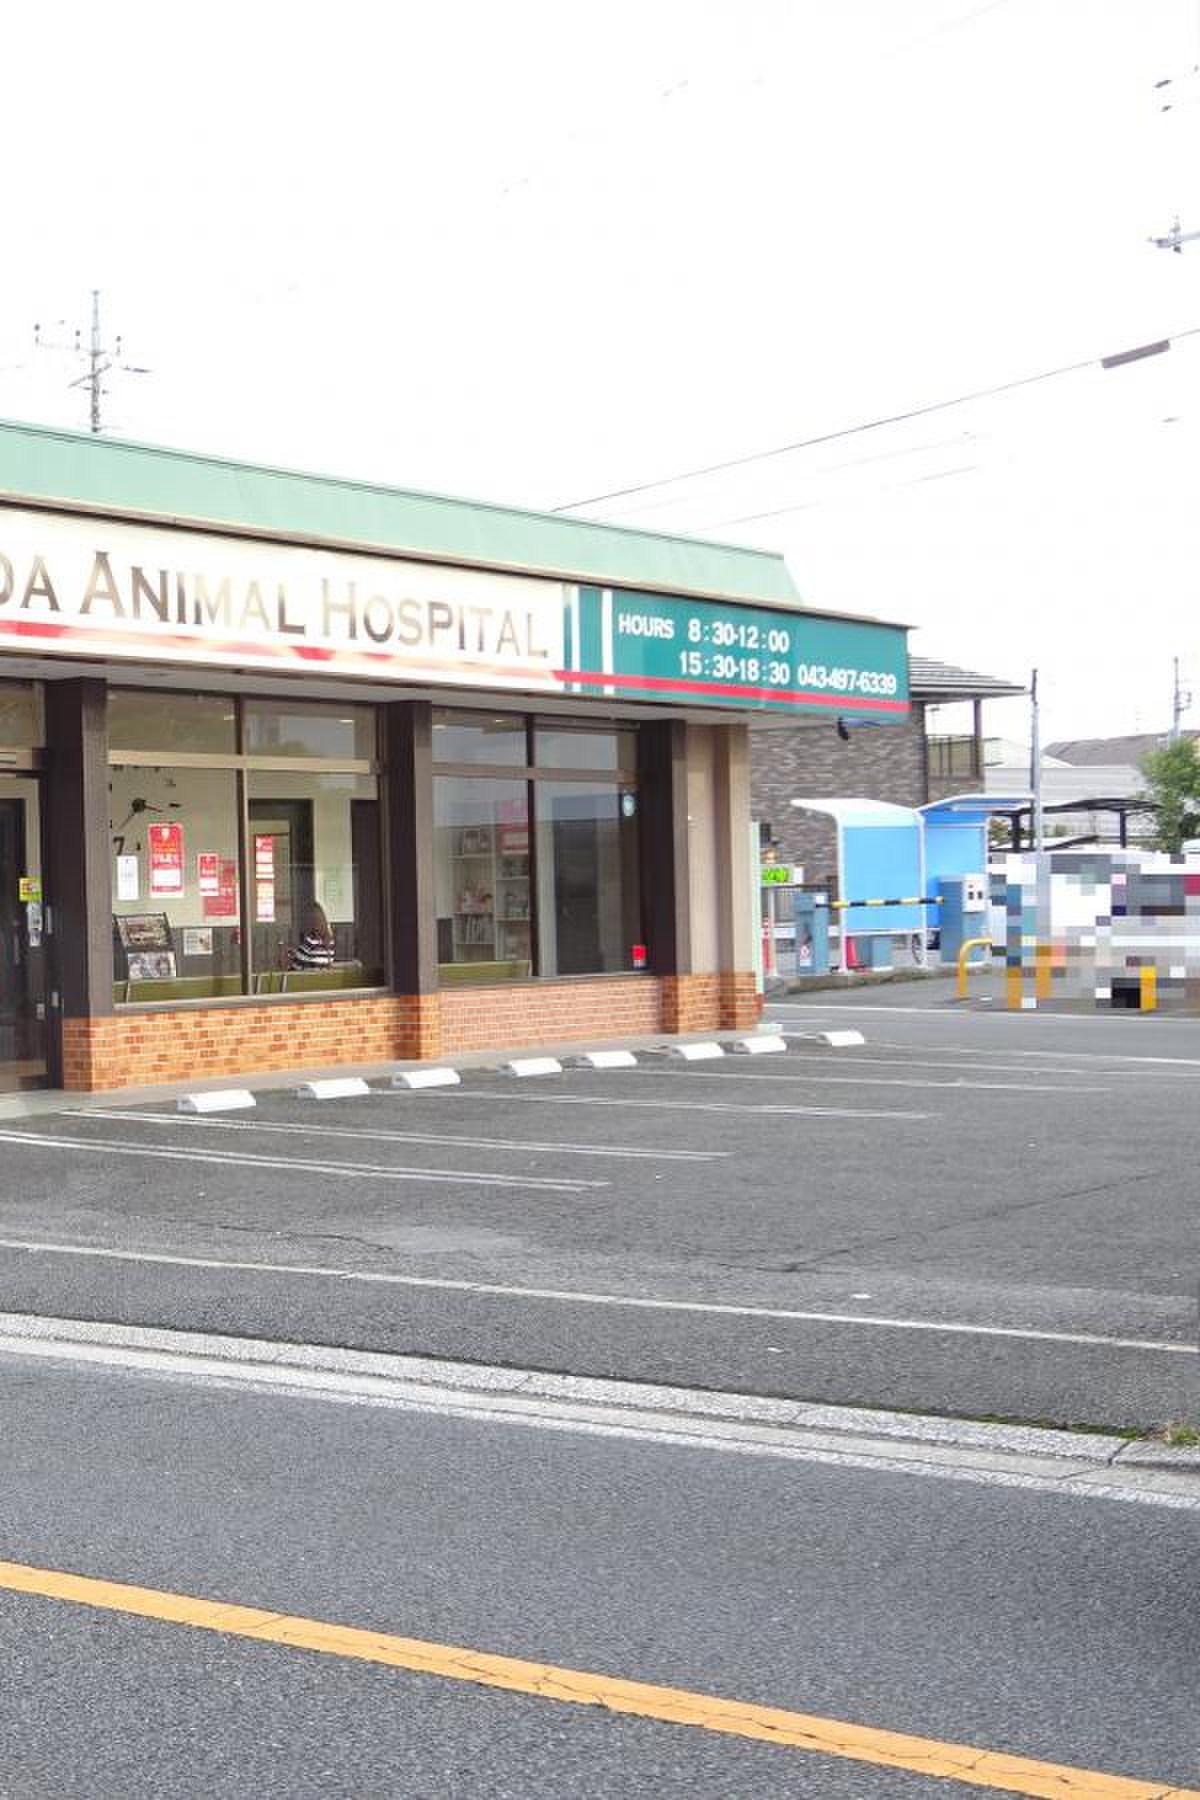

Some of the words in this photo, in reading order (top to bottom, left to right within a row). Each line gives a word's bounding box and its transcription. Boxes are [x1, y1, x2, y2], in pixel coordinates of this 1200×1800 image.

[78, 551, 307, 637] ANIMAL
[320, 577, 548, 659] HOSPITAL
[618, 613, 675, 640] HOURS
[797, 663, 898, 696] 043-497-6339
